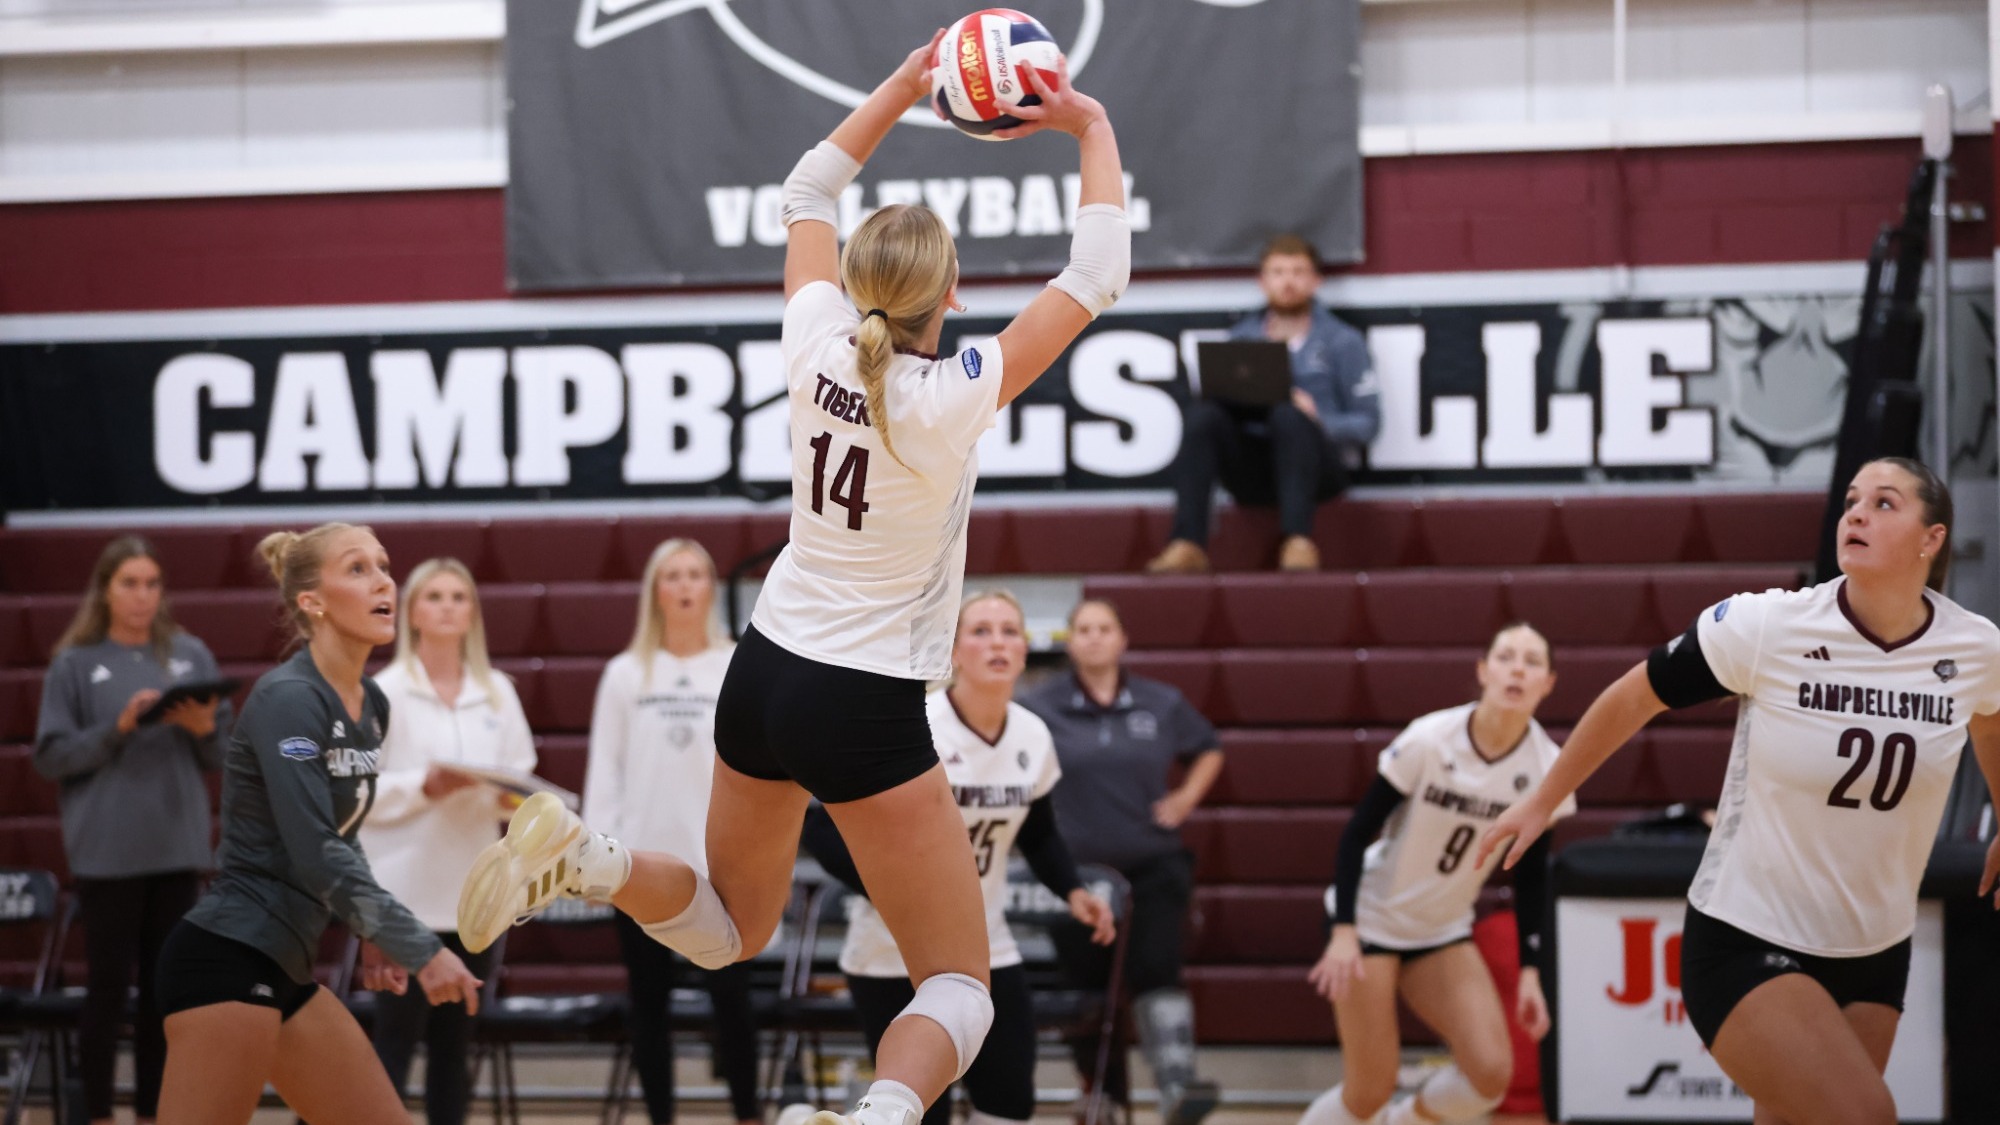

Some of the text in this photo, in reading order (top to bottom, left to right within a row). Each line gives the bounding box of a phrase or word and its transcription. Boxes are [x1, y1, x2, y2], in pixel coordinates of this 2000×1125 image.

[961, 30, 989, 101] molten
[810, 431, 870, 531] 14
[1798, 682, 1955, 725] CAMPBELLSVILLE
[1827, 727, 1917, 811] 20
[1437, 824, 1476, 875] 9
